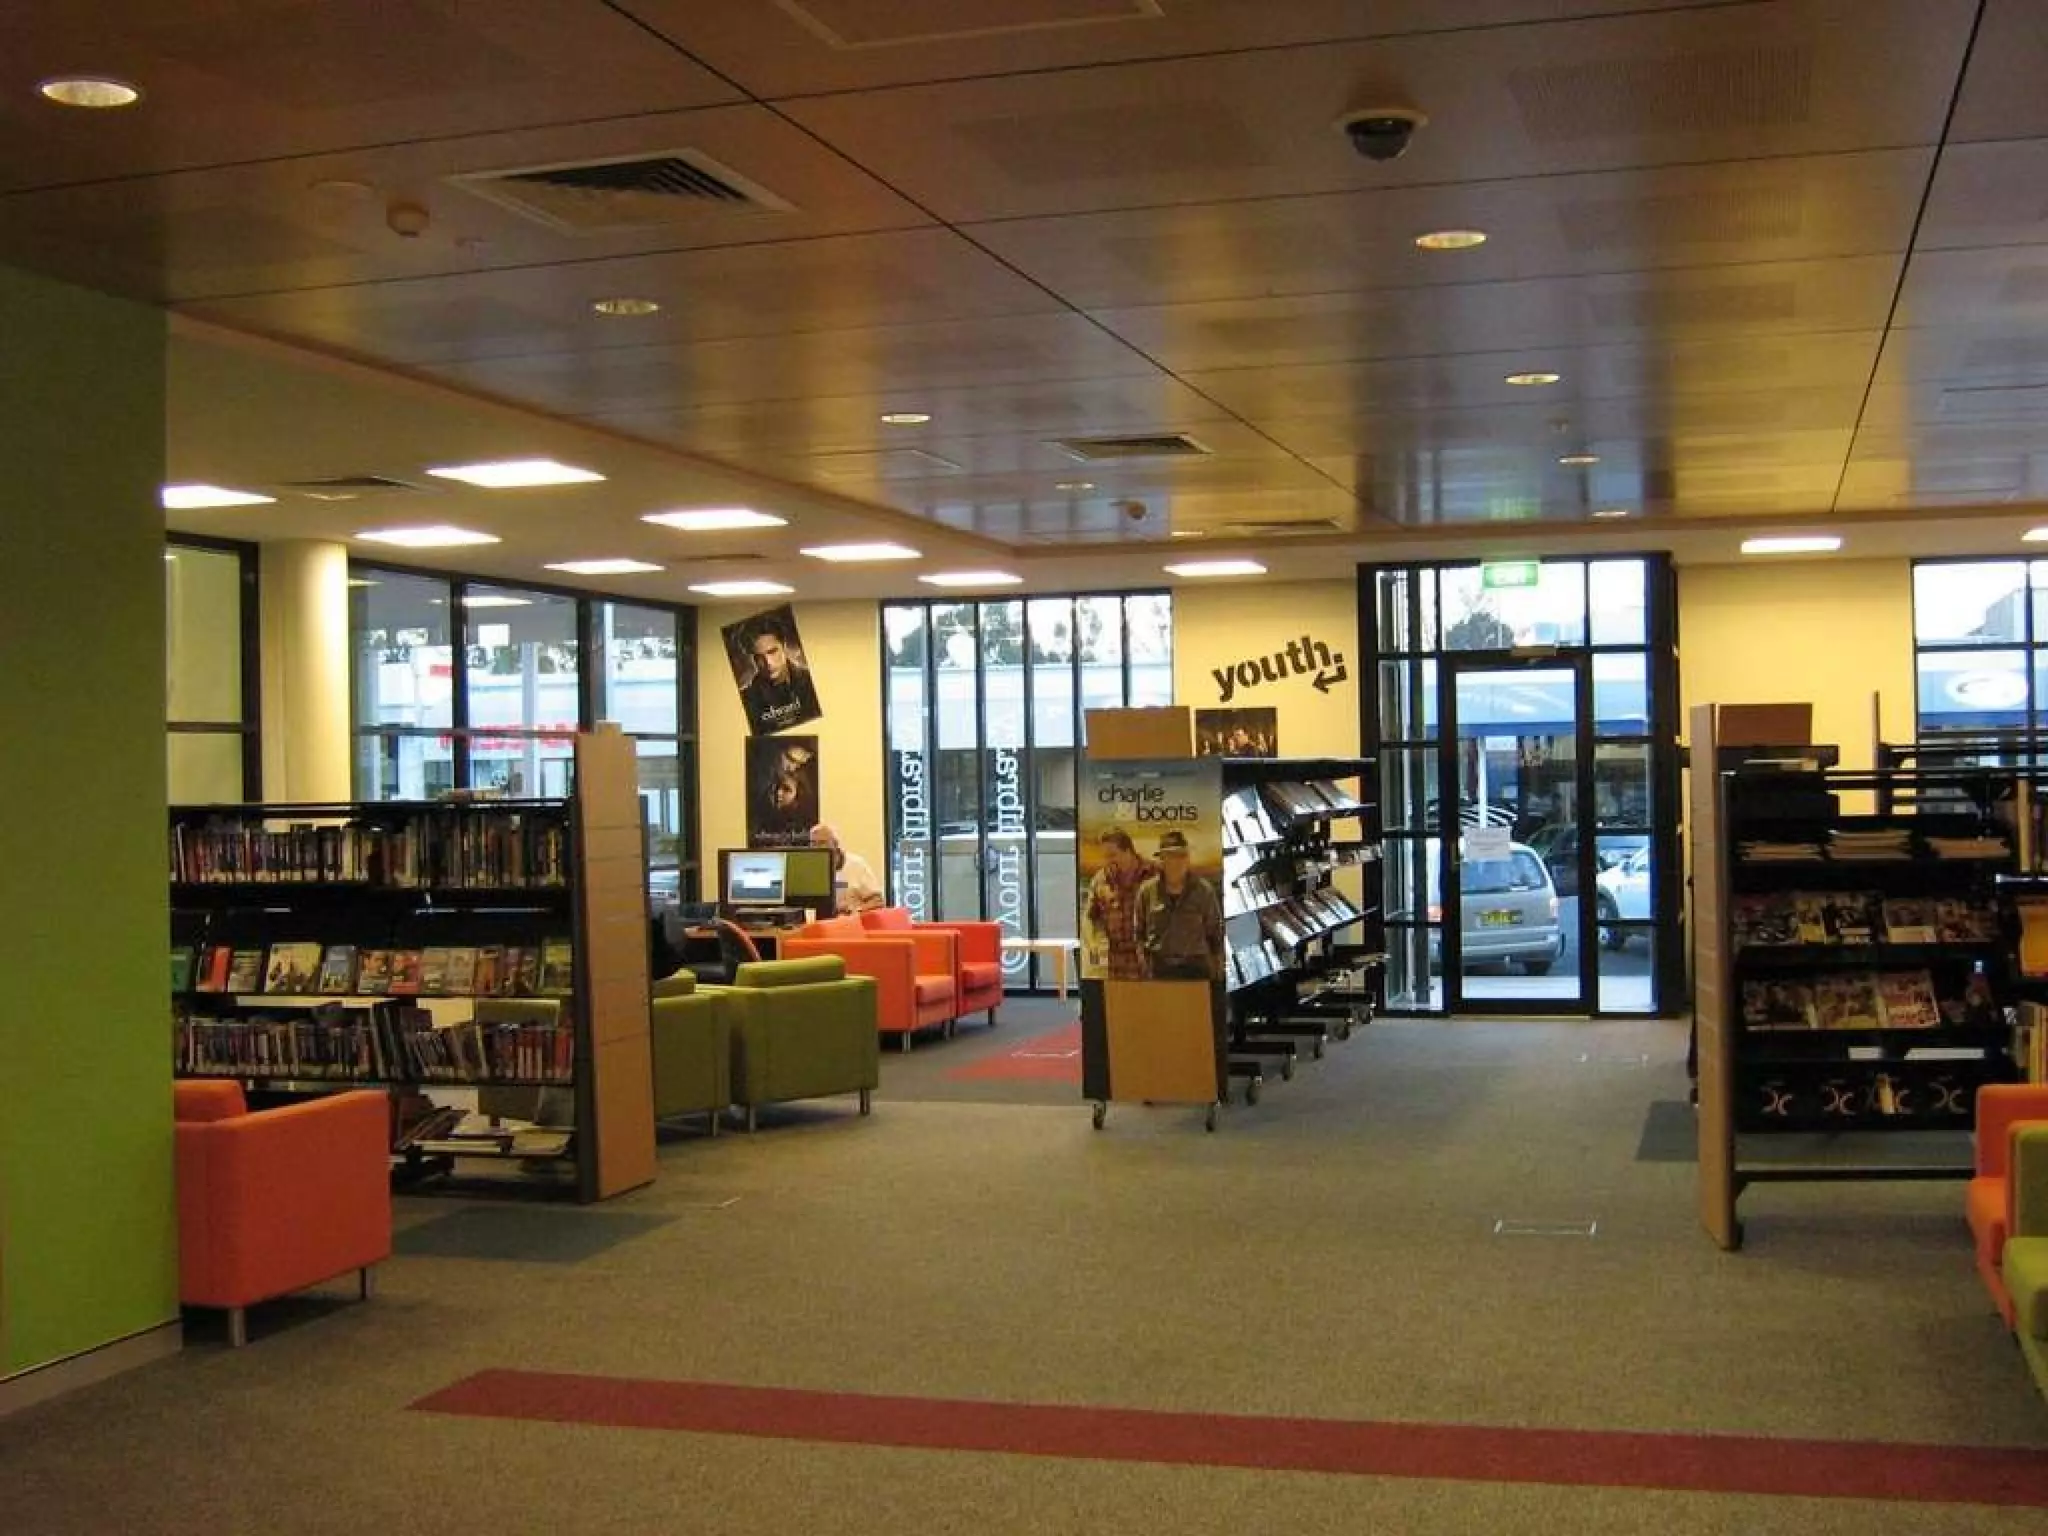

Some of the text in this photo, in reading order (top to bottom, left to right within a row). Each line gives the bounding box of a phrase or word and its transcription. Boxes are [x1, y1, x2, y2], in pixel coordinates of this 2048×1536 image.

[1212, 635, 1331, 702] youth
[1098, 783, 1164, 802] charlie
[1136, 802, 1198, 821] boots
